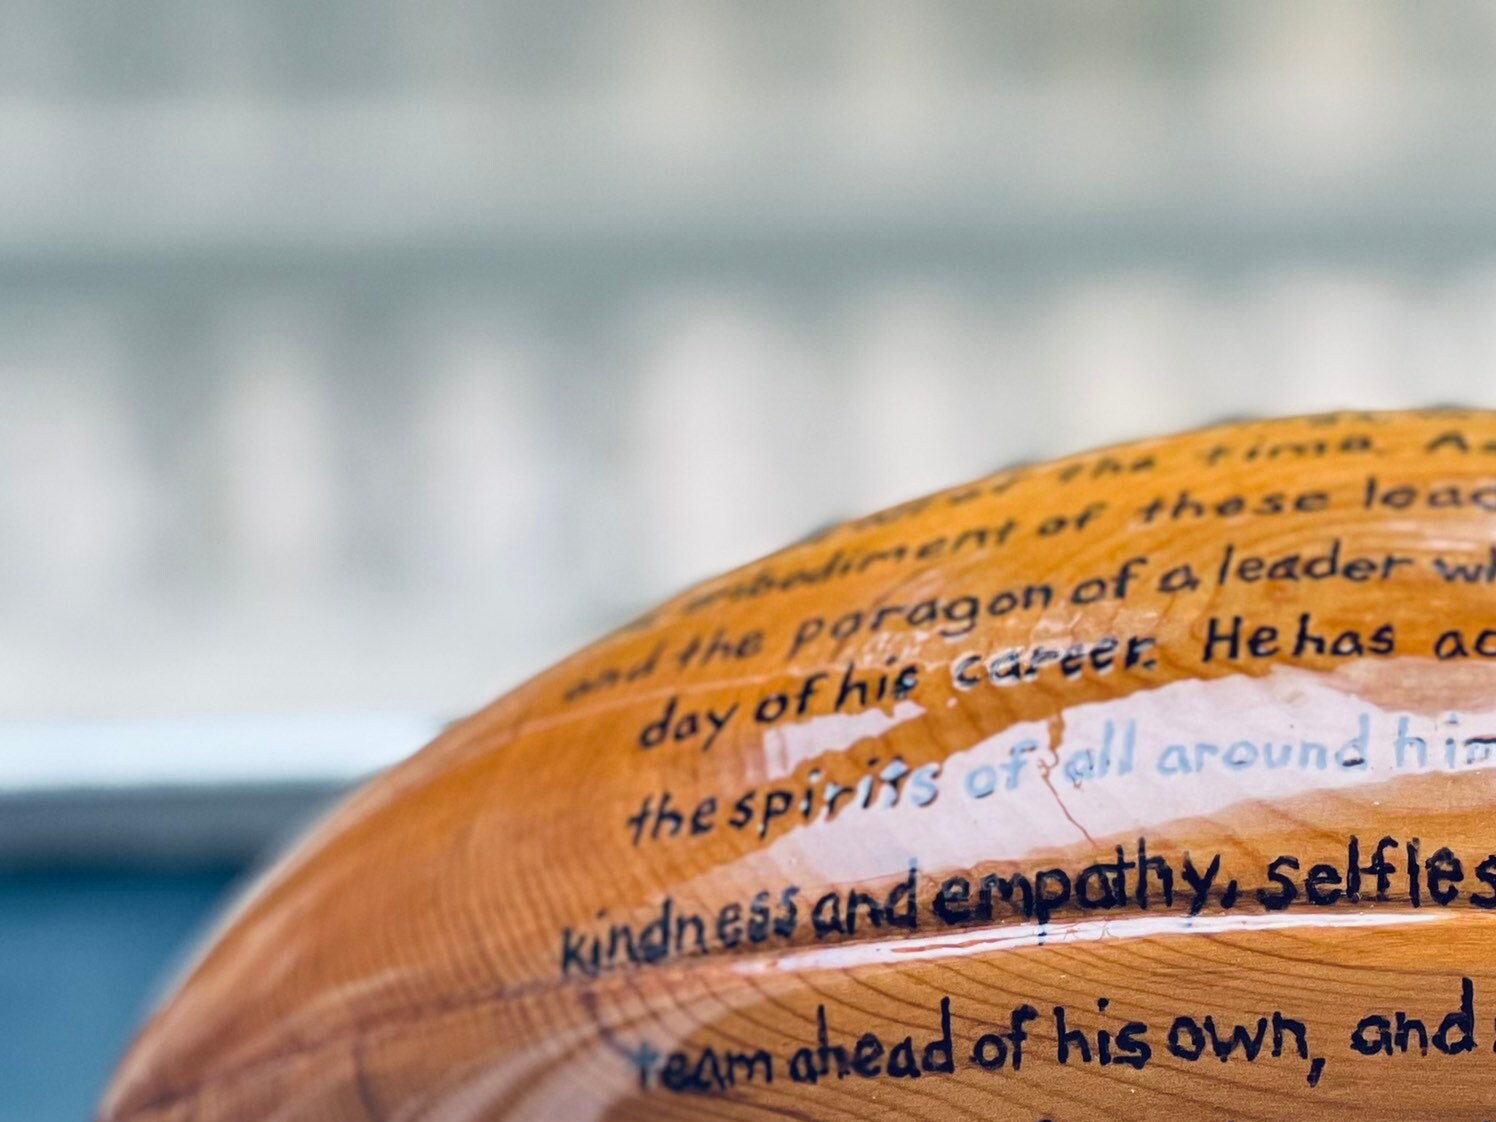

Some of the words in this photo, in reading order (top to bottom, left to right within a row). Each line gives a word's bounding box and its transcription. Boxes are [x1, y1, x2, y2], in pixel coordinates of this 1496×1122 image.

[1035, 498, 1110, 539] of
[1137, 487, 1331, 525] these
[675, 626, 766, 672] the
[788, 580, 1055, 658] paragon
[1069, 556, 1150, 601] of
[1158, 563, 1201, 596] a
[1216, 537, 1415, 588] leader
[638, 696, 741, 752] day
[752, 672, 829, 724] of
[834, 656, 920, 709] his
[954, 634, 1159, 687] career.
[1202, 614, 1282, 664] He
[1292, 612, 1397, 660] has
[626, 790, 717, 847] the
[728, 755, 942, 839] spirits
[964, 738, 1043, 801] of
[1063, 717, 1136, 784] all
[1156, 712, 1372, 776] around
[561, 884, 800, 976] kindness
[811, 856, 920, 938] and
[931, 836, 1238, 945] empathy,
[626, 1036, 775, 1097] team
[786, 995, 958, 1088] ahead
[966, 1002, 1039, 1074] of
[1053, 996, 1153, 1070] his
[1166, 1009, 1327, 1088] own,
[1349, 977, 1480, 1057] and
